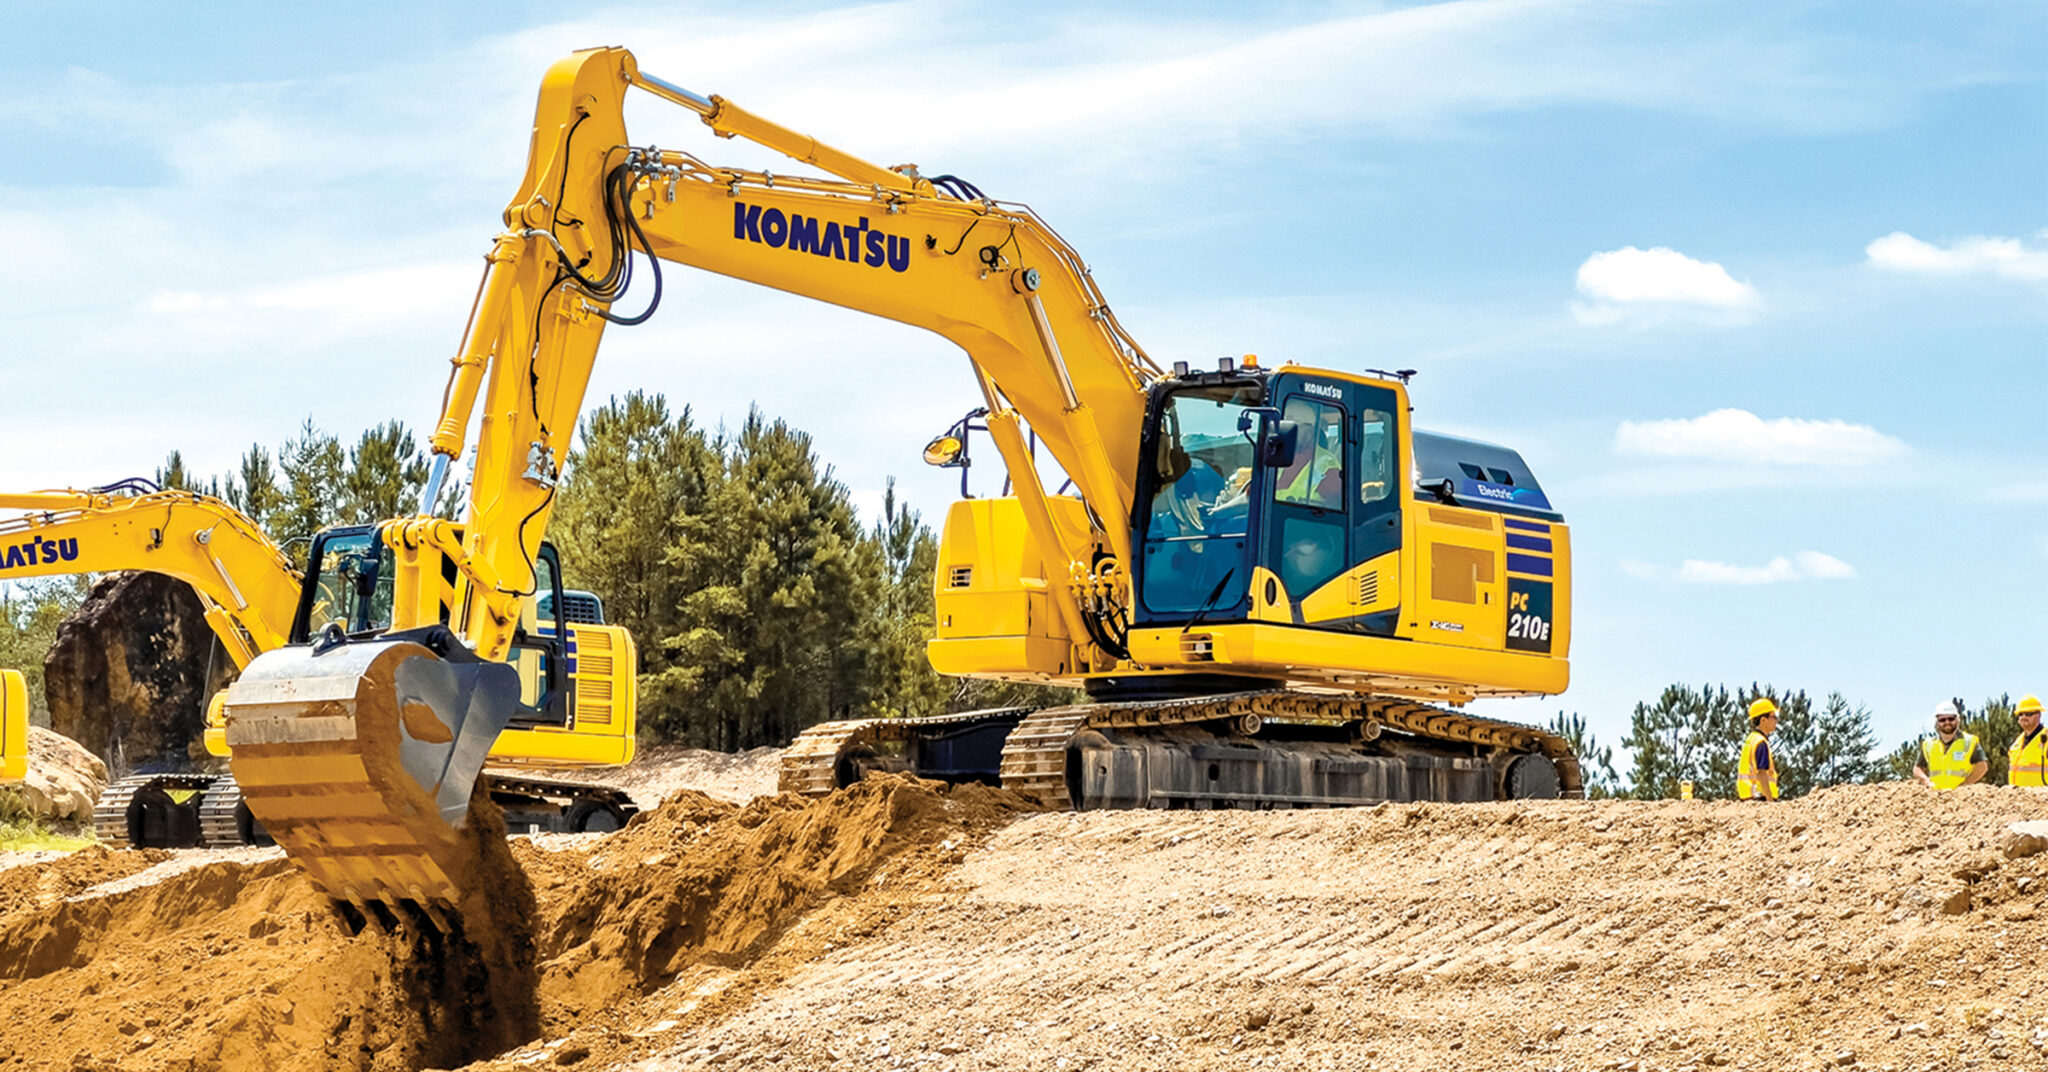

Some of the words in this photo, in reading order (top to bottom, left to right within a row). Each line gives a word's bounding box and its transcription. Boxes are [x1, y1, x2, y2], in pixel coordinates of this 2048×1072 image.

[734, 202, 909, 273] KOMATSU
[1304, 382, 1342, 400] KOMATSU
[0, 535, 79, 569] ATSU
[1510, 591, 1529, 611] PC
[1508, 613, 1550, 641] 210E
